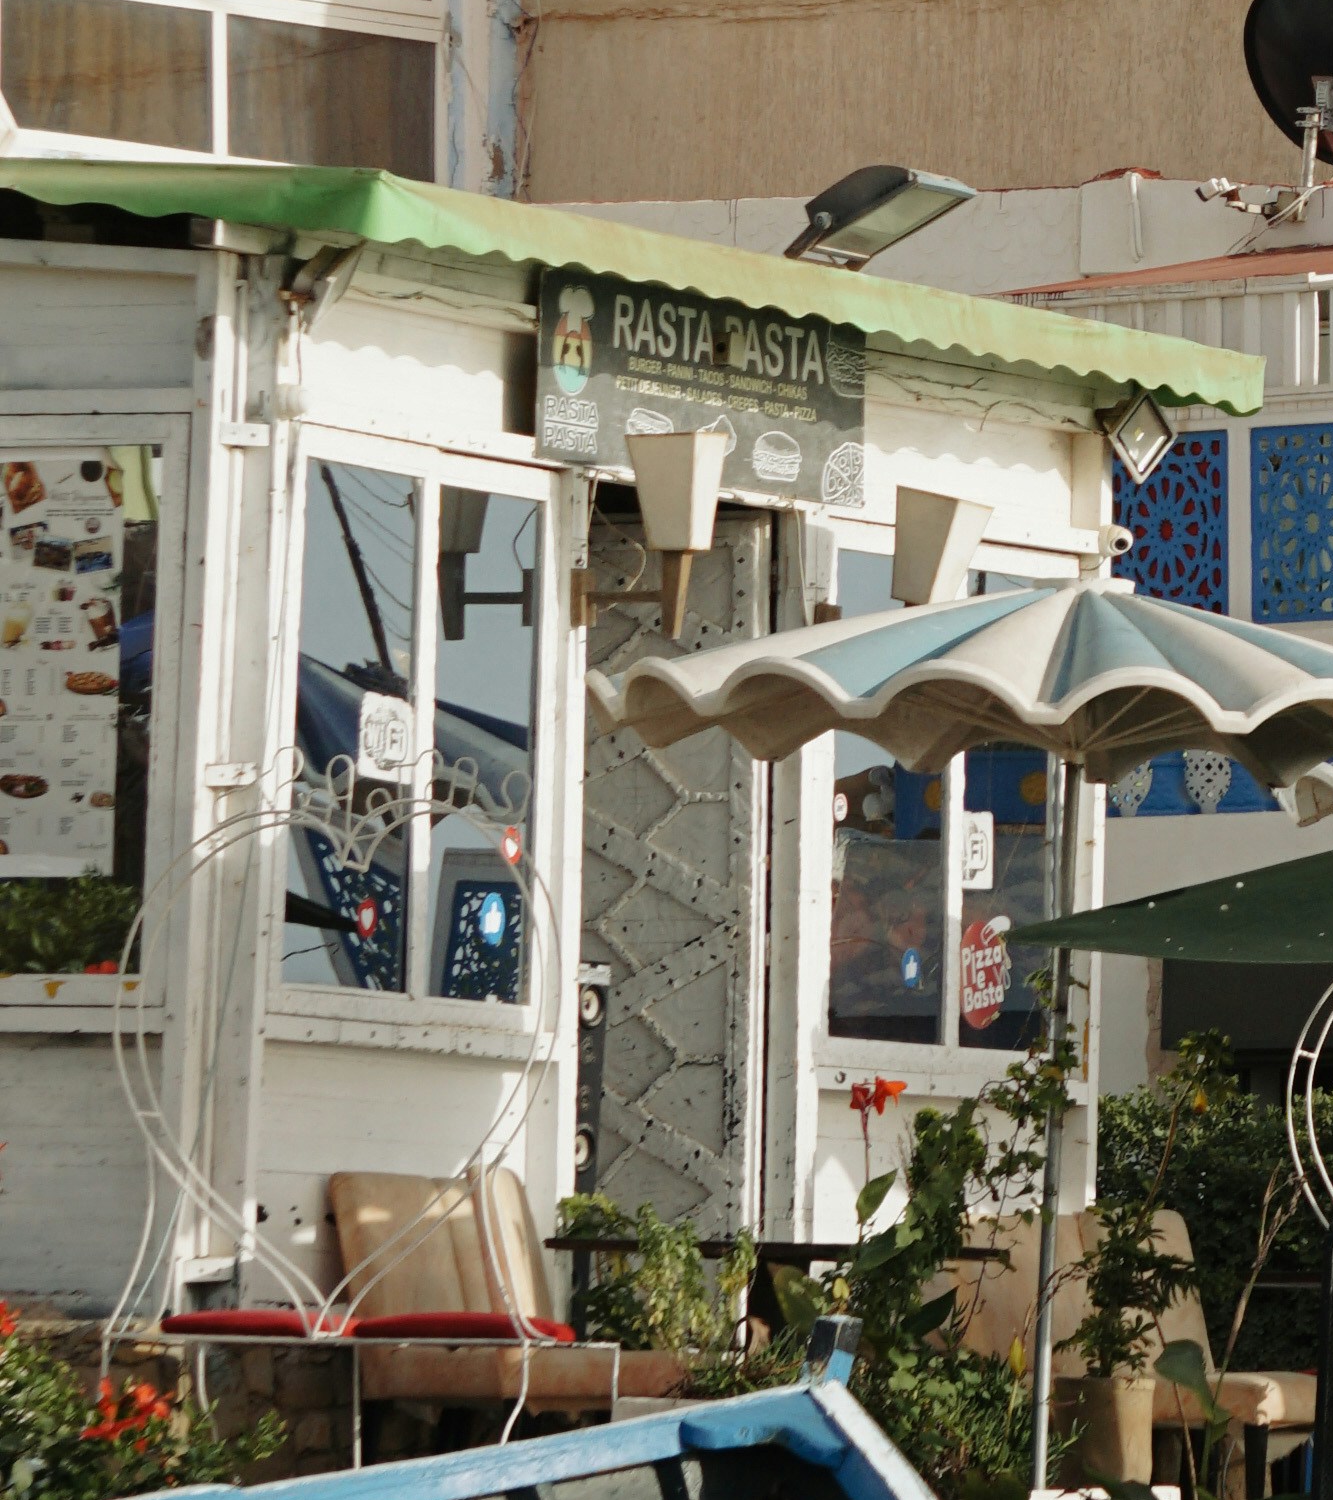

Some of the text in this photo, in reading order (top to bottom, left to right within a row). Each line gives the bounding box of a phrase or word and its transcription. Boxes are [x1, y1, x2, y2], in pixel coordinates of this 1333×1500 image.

[613, 294, 714, 365] RASTA
[628, 356, 662, 376] BURGER
[698, 369, 725, 387] TACOS
[730, 375, 774, 394] SANDWICH
[544, 394, 599, 424] RASTA
[615, 374, 638, 392] PETIT
[764, 401, 789, 419] PASTA
[794, 405, 818, 422] PIZZA
[543, 426, 598, 455] PASTA
[961, 944, 1003, 986] Pizza
[976, 970, 986, 988] e
[963, 983, 1005, 1014] Basta
